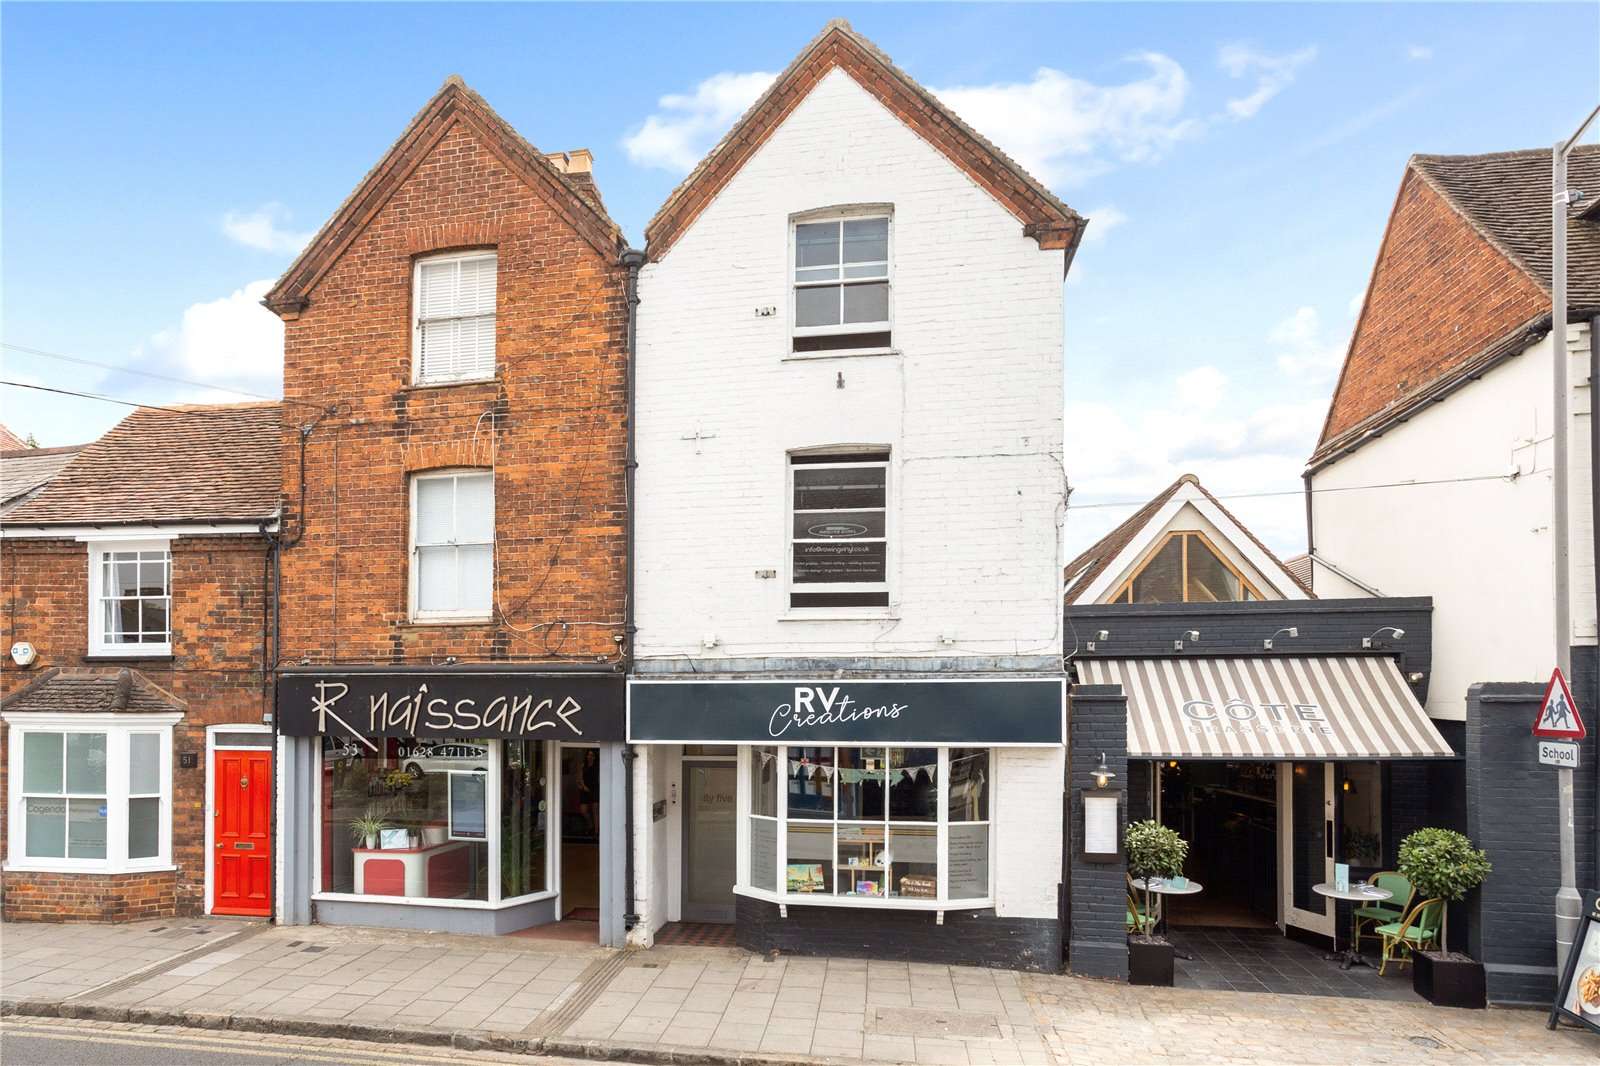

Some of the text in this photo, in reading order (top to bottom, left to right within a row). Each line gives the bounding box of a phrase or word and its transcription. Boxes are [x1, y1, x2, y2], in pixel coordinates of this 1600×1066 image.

[794, 686, 840, 713] RV
[1182, 697, 1326, 721] CÔTE
[768, 694, 909, 737] Creations
[342, 743, 358, 756] 53
[398, 746, 484, 758] 01628 471135
[1542, 746, 1574, 761] School
